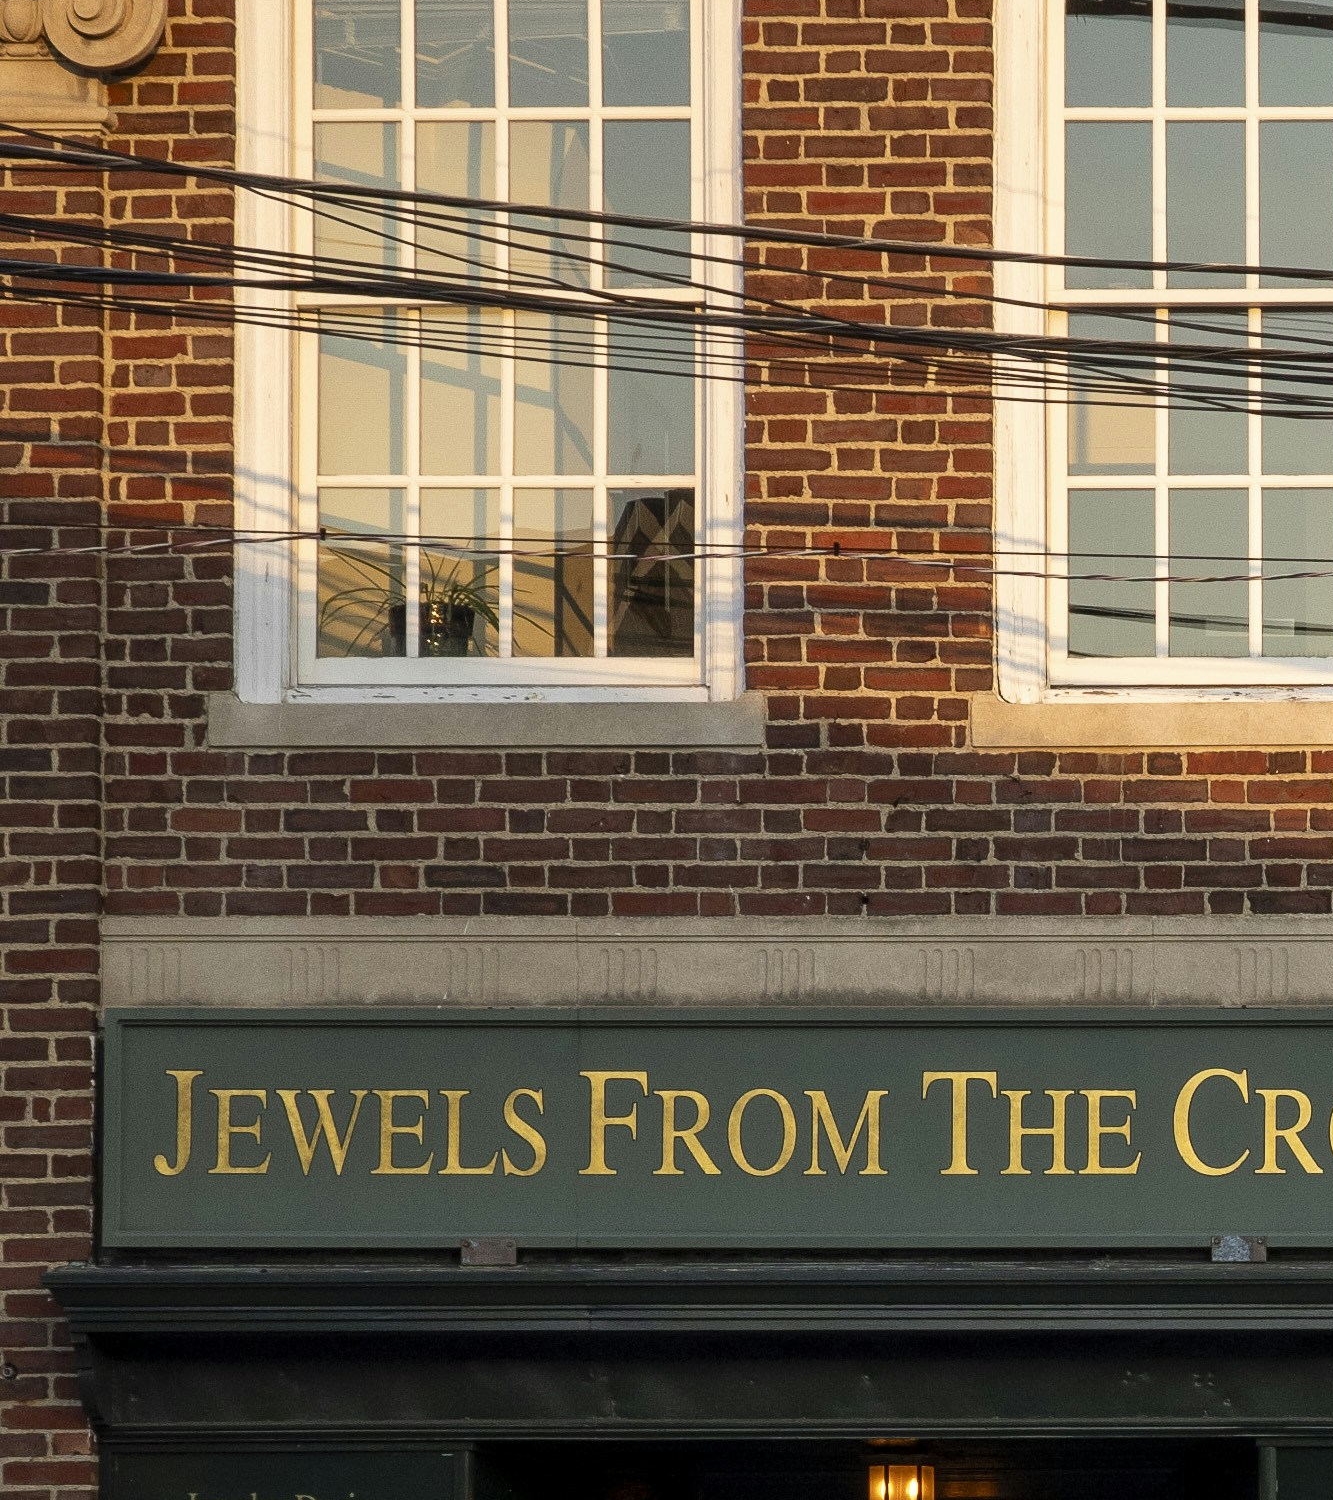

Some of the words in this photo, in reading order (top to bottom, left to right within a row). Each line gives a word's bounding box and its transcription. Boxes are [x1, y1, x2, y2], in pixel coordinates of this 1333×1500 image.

[153, 1069, 548, 1178] JEWELS
[577, 1070, 889, 1178] FROM
[921, 1070, 1143, 1177] THE
